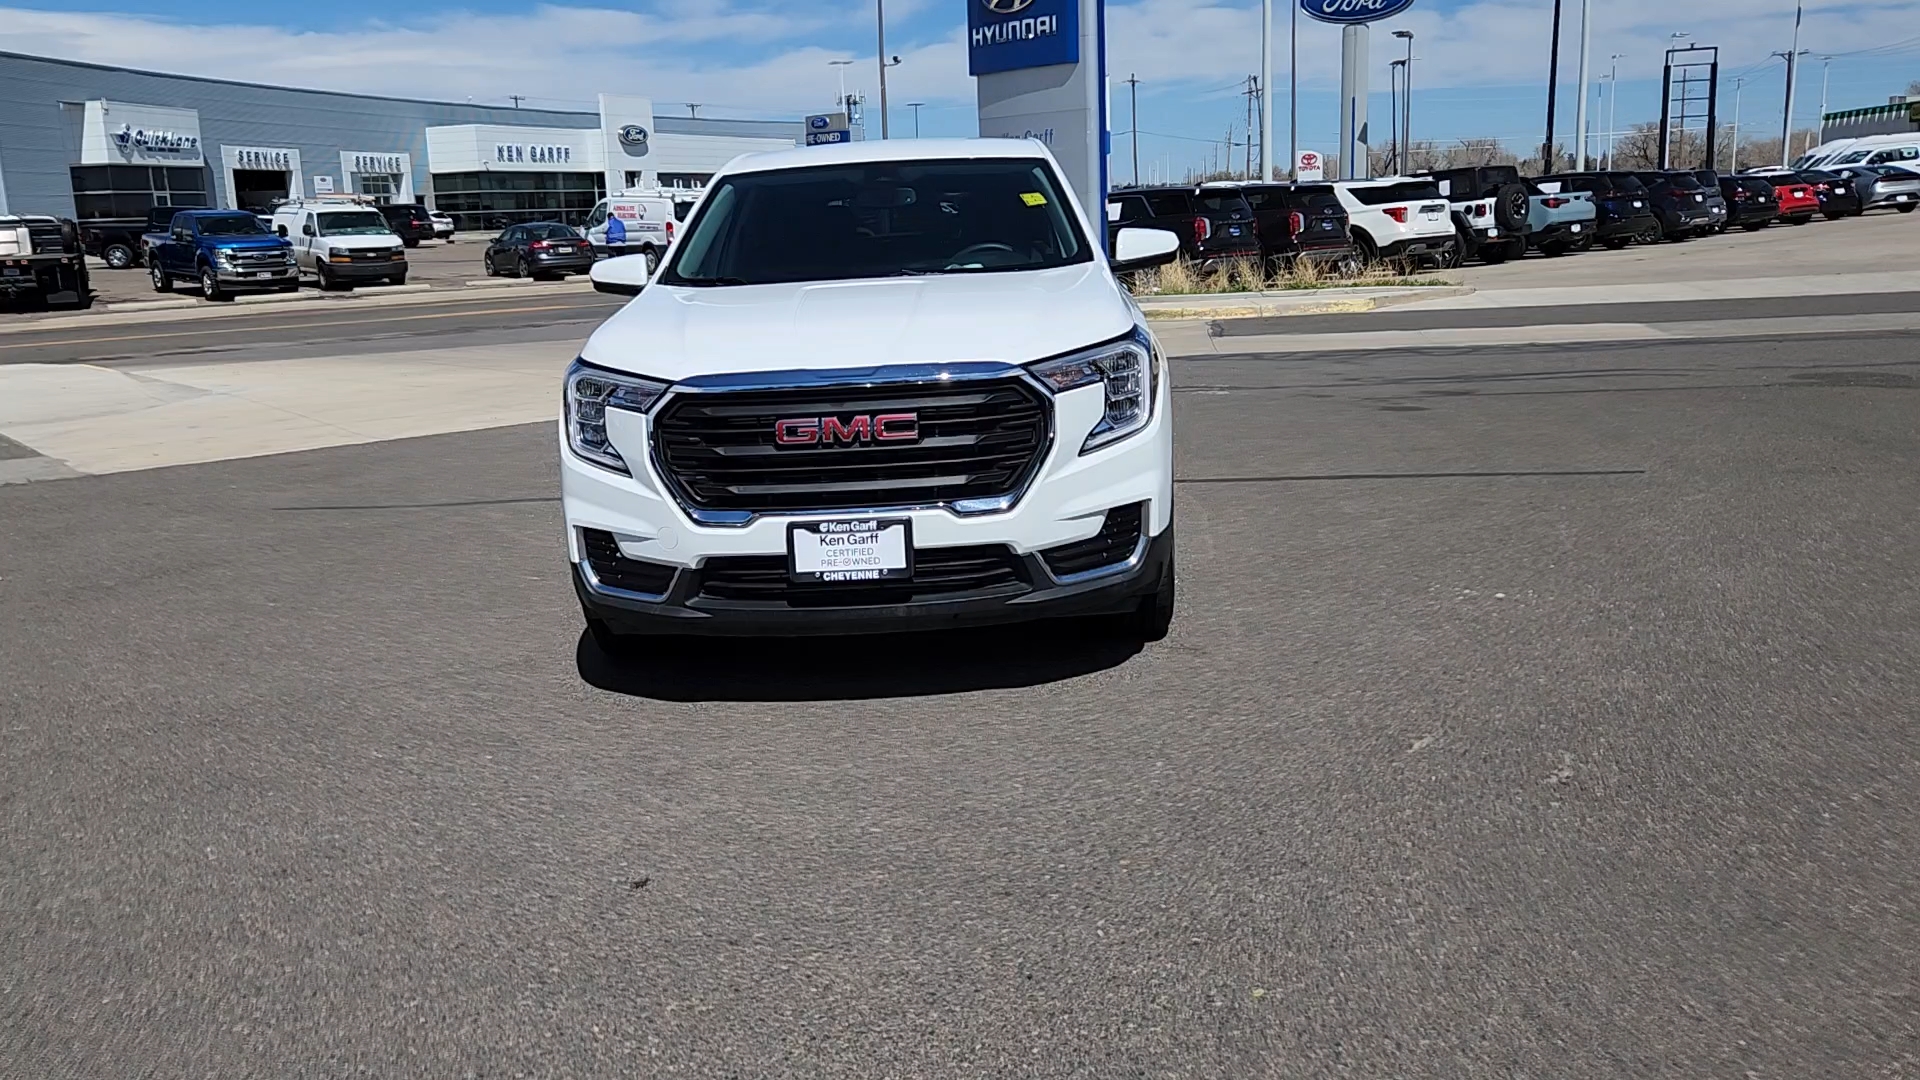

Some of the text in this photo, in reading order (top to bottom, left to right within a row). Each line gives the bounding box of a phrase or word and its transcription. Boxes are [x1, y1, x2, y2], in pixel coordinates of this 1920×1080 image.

[972, 14, 1058, 48] HYUNDAI
[627, 128, 645, 141] Ford
[806, 132, 841, 144] RE-OWNED
[238, 150, 289, 163] SERVICE
[497, 145, 570, 160] KEN GARFF
[355, 156, 400, 168] SERVICE
[775, 412, 919, 445] GMC
[829, 521, 878, 532] Ken Garff
[819, 533, 880, 547] Ken Garff
[826, 547, 874, 558] CERTIFIED
[820, 556, 881, 567] PRE-OWNED
[823, 570, 880, 581] CHEYENNE
